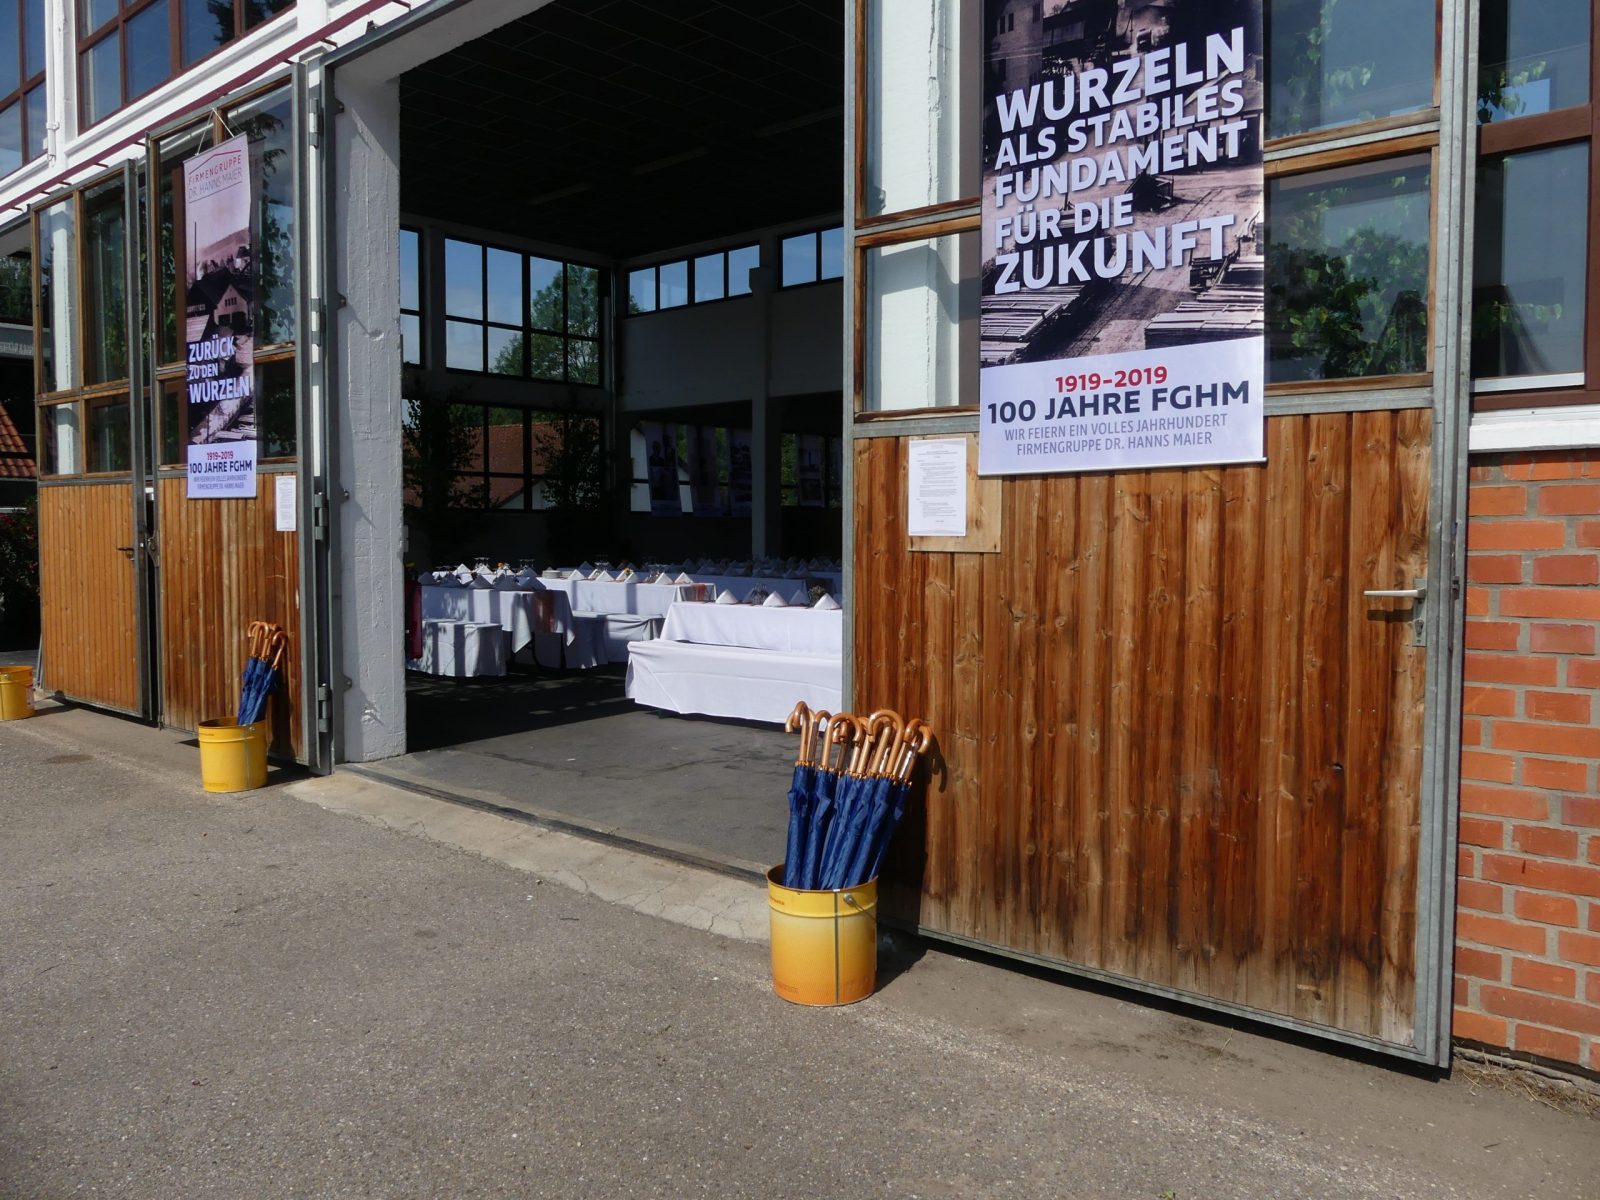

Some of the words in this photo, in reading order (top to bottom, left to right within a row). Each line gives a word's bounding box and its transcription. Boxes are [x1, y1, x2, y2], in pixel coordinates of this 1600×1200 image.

[996, 26, 1244, 133] WURZELN
[995, 127, 1056, 170] ALS
[1068, 80, 1244, 153] STABILES
[188, 155, 242, 186] FIRMENGRUPPE
[995, 119, 1247, 207] FUNDAMENT
[995, 206, 1062, 248] FÜR
[1074, 193, 1133, 234] DIE
[994, 214, 1234, 295] ZUKUNFT
[189, 334, 235, 363] ZURÜCK
[189, 365, 200, 380] ZU
[201, 363, 218, 378] DEN
[1055, 366, 1168, 393] 1919-2019
[189, 376, 250, 403] WURZELN
[987, 399, 1036, 424] 100
[1044, 390, 1141, 420] JAHRE
[1152, 380, 1250, 411] FGHM
[1005, 428, 1026, 441] WIR
[1028, 425, 1066, 439] FEIERN
[1069, 424, 1088, 437] EIN
[1091, 420, 1134, 435] VOLLES
[1136, 413, 1228, 433] JAHRHUNDERT
[206, 451, 234, 460] 1919-2019
[1017, 439, 1102, 455] FIRMENGRUPPE
[1105, 437, 1125, 450] DR.
[1128, 434, 1169, 449] HANNS
[1173, 431, 1212, 446] MAIER
[189, 463, 203, 474] 100
[204, 461, 228, 473] JAHRE
[229, 460, 252, 472] FGHM
